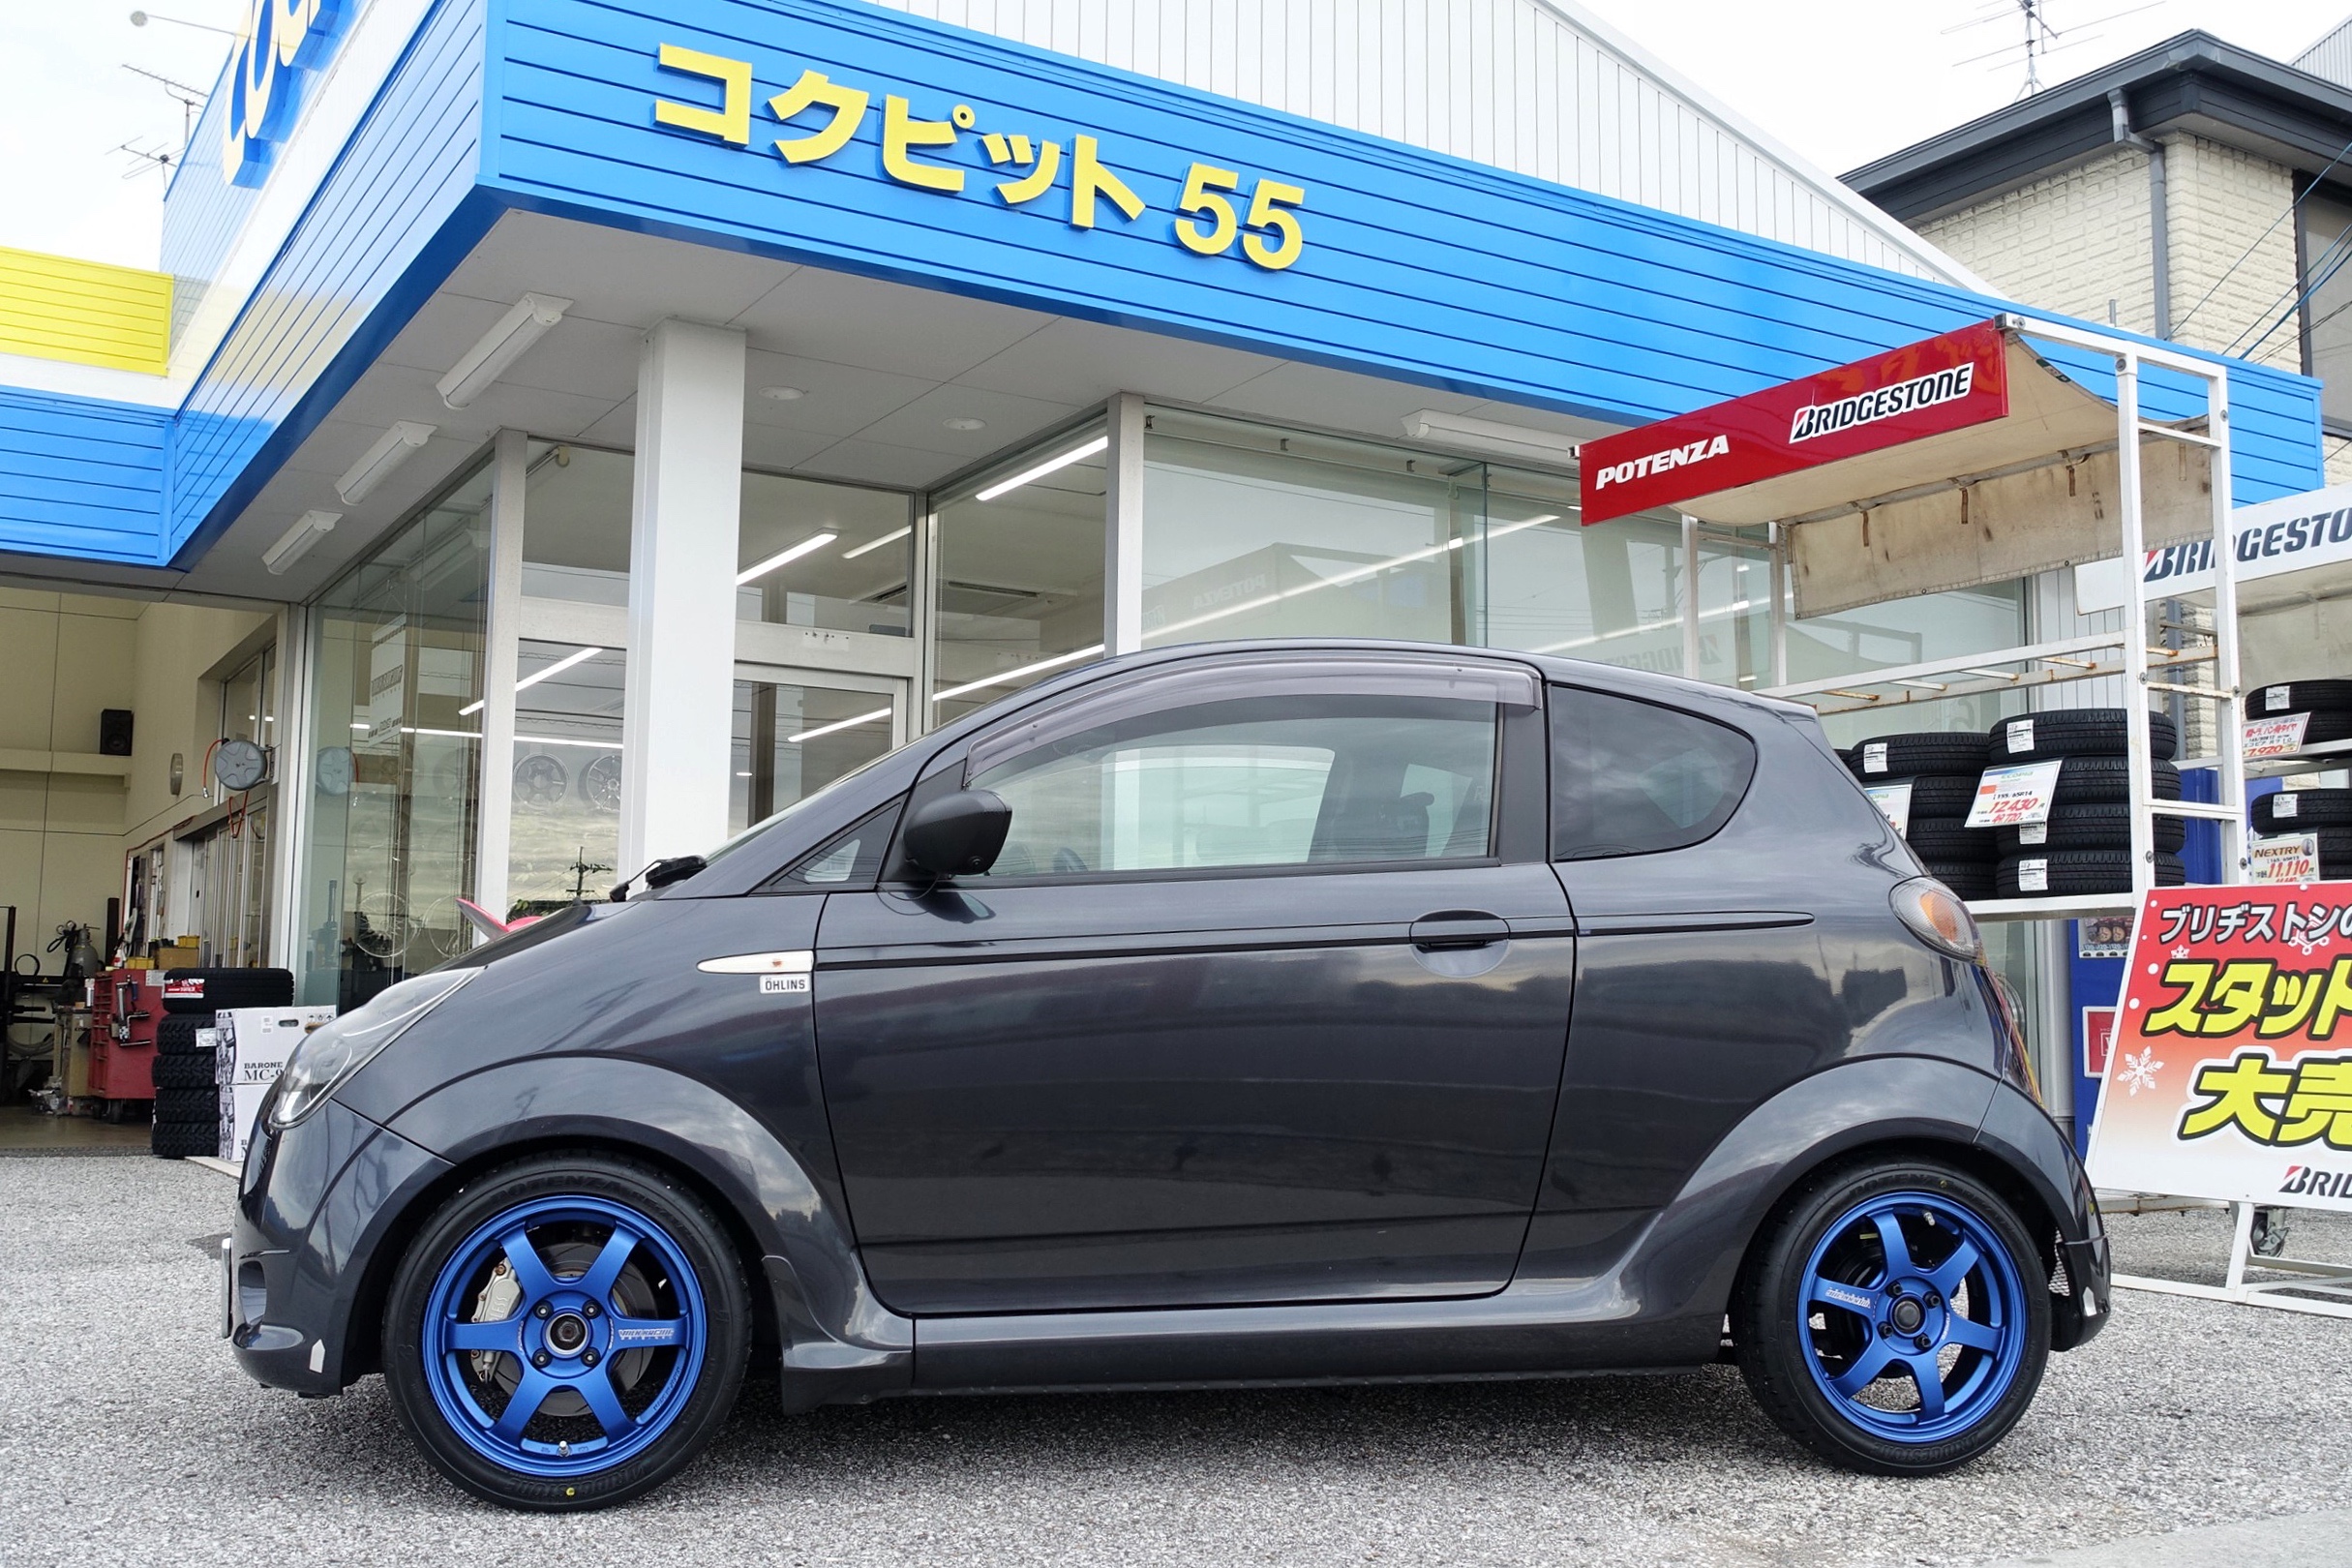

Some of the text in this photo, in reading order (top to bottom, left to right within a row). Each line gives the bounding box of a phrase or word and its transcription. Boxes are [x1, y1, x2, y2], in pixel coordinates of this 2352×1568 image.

[655, 43, 1305, 271] コクピット 55
[1791, 364, 1973, 442] BRIDGESTONE
[1596, 435, 1730, 490] POTENZA
[2143, 508, 2352, 583] BRIGESTO
[2254, 845, 2301, 858] NEXTRY
[765, 978, 805, 990] ÖHLINS
